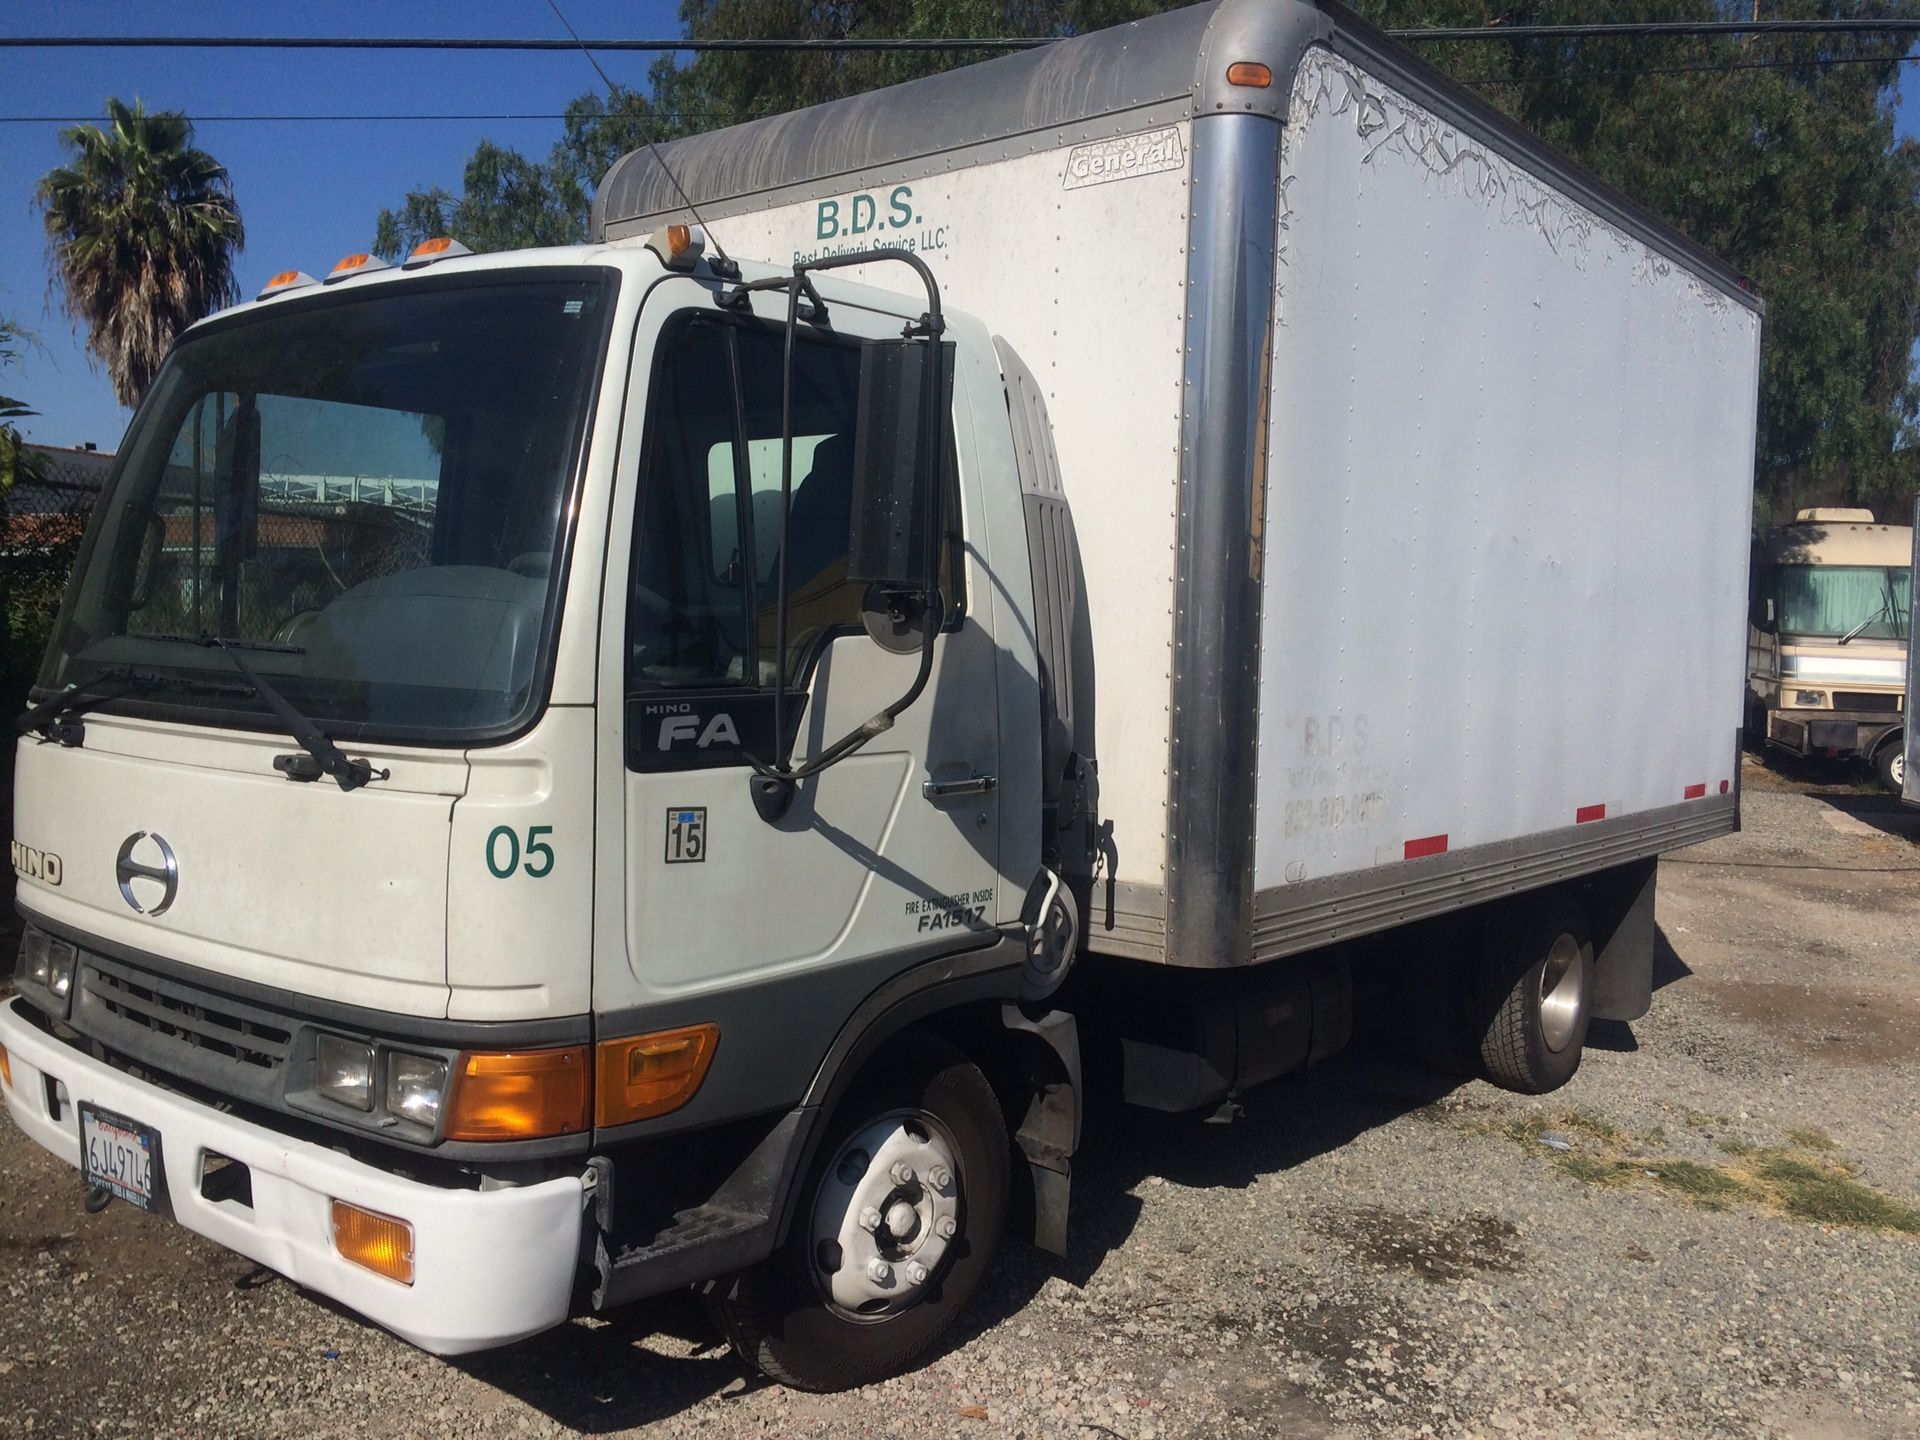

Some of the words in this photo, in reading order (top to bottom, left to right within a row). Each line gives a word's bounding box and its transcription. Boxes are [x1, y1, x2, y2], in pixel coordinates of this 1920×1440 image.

[816, 186, 923, 240] B.D.S.
[793, 249, 818, 265] Best
[646, 703, 691, 714] HINO
[657, 713, 741, 752] FA
[486, 825, 555, 879] 05
[671, 823, 702, 858] 15
[11, 839, 63, 887] HINO
[905, 901, 920, 915] FIRE
[921, 892, 970, 913] EXTINGUISHER
[972, 888, 993, 904] INSIDE
[917, 905, 987, 933] FA1517
